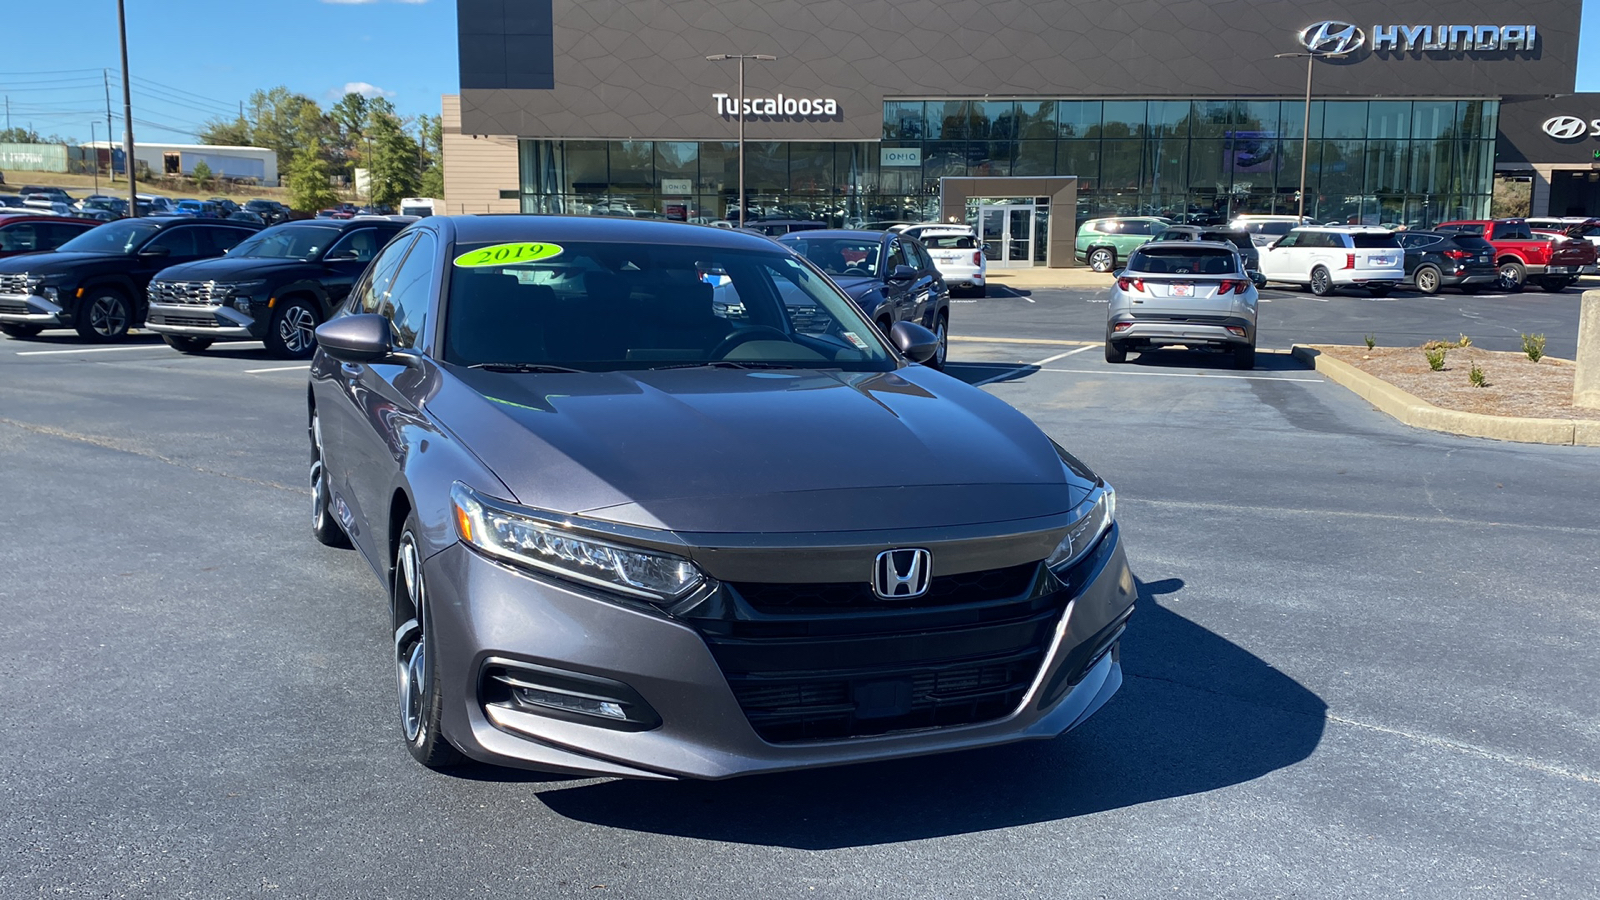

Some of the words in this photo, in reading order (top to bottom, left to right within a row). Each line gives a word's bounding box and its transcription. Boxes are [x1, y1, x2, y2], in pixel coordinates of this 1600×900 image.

[1372, 25, 1537, 51] HYUNDAI
[712, 93, 837, 115] Tuscaloosa
[476, 244, 544, 264] 2019
